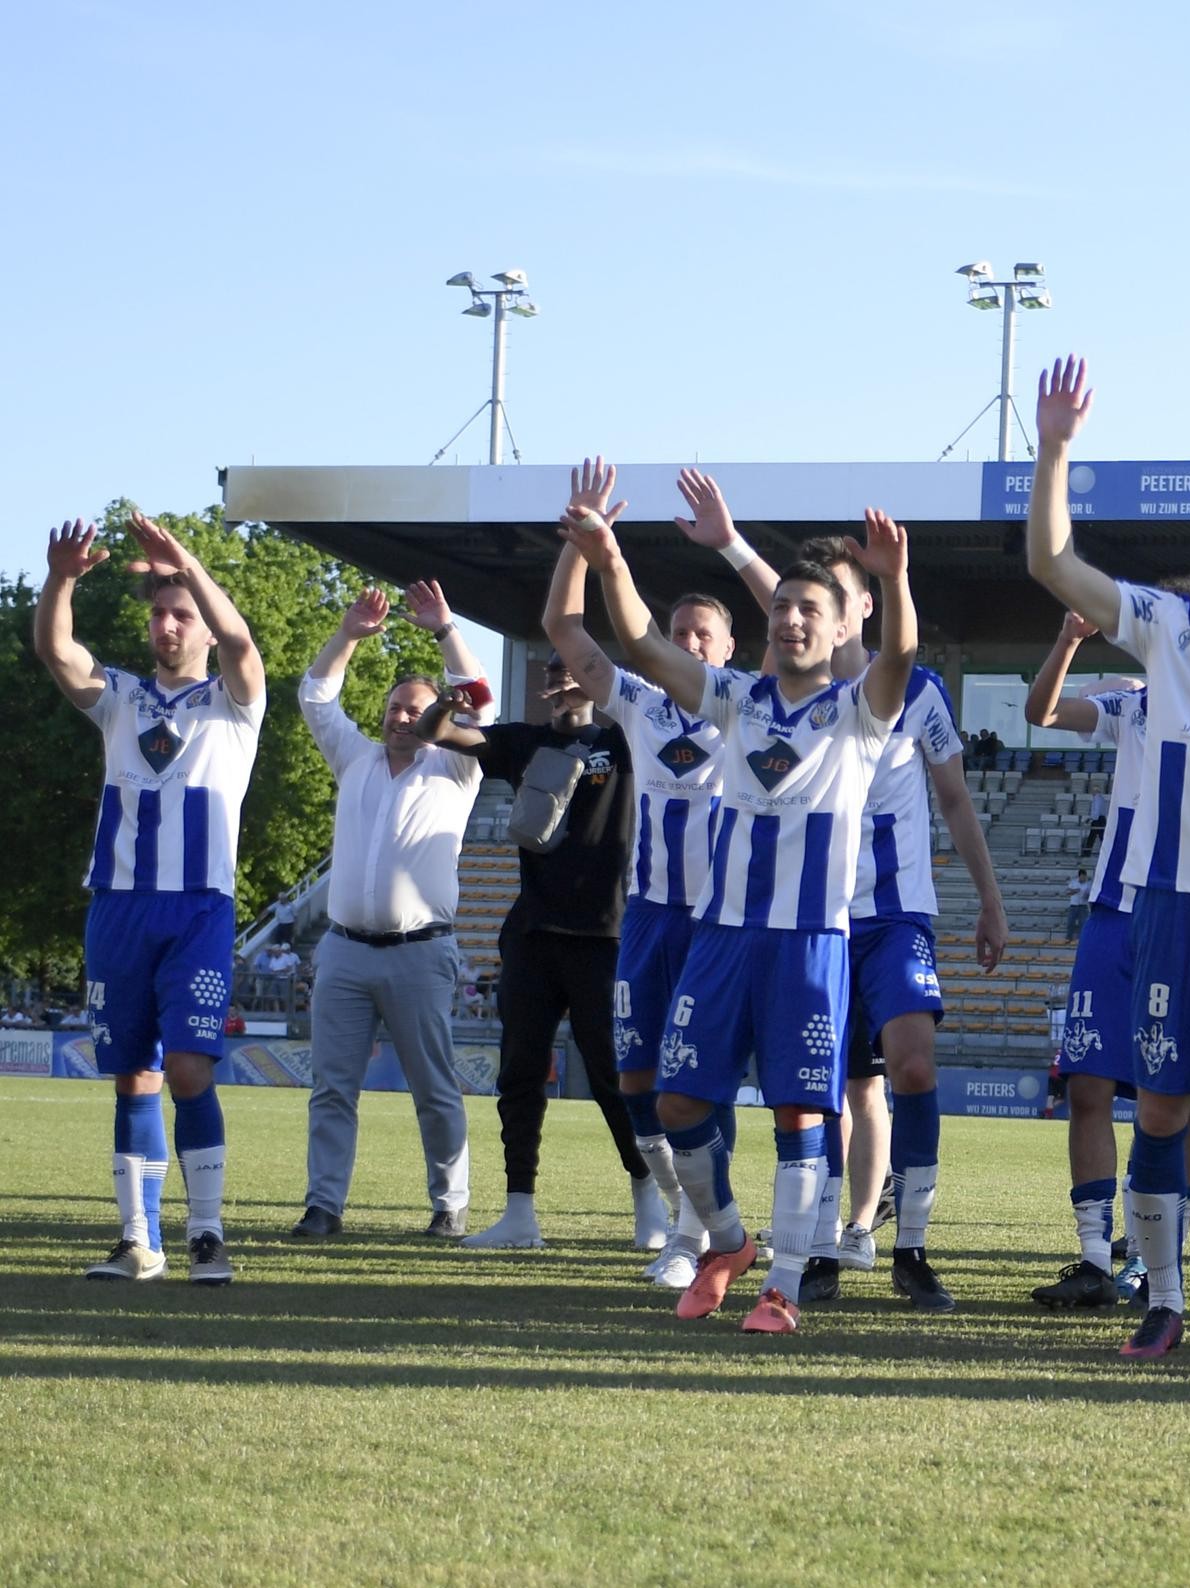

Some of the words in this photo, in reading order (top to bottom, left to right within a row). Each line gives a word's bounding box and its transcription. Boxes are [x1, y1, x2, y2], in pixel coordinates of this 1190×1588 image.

[1086, 503, 1095, 514] U.
[1140, 503, 1156, 514] WIJ
[1158, 503, 1178, 514] ZIJN
[769, 721, 795, 734] JAKO
[673, 749, 694, 764] JB
[1071, 991, 1093, 1018] 11
[1148, 983, 1170, 1018] 8
[674, 995, 695, 1027] 6
[195, 1029, 218, 1040] JAKO
[966, 1082, 1016, 1097] PEETERS
[999, 1106, 1008, 1115] ER
[1010, 1107, 1030, 1115] VOOR
[1112, 1110, 1133, 1119] VOOR
[782, 1162, 817, 1171] JAKO
[822, 1195, 834, 1203] KO
